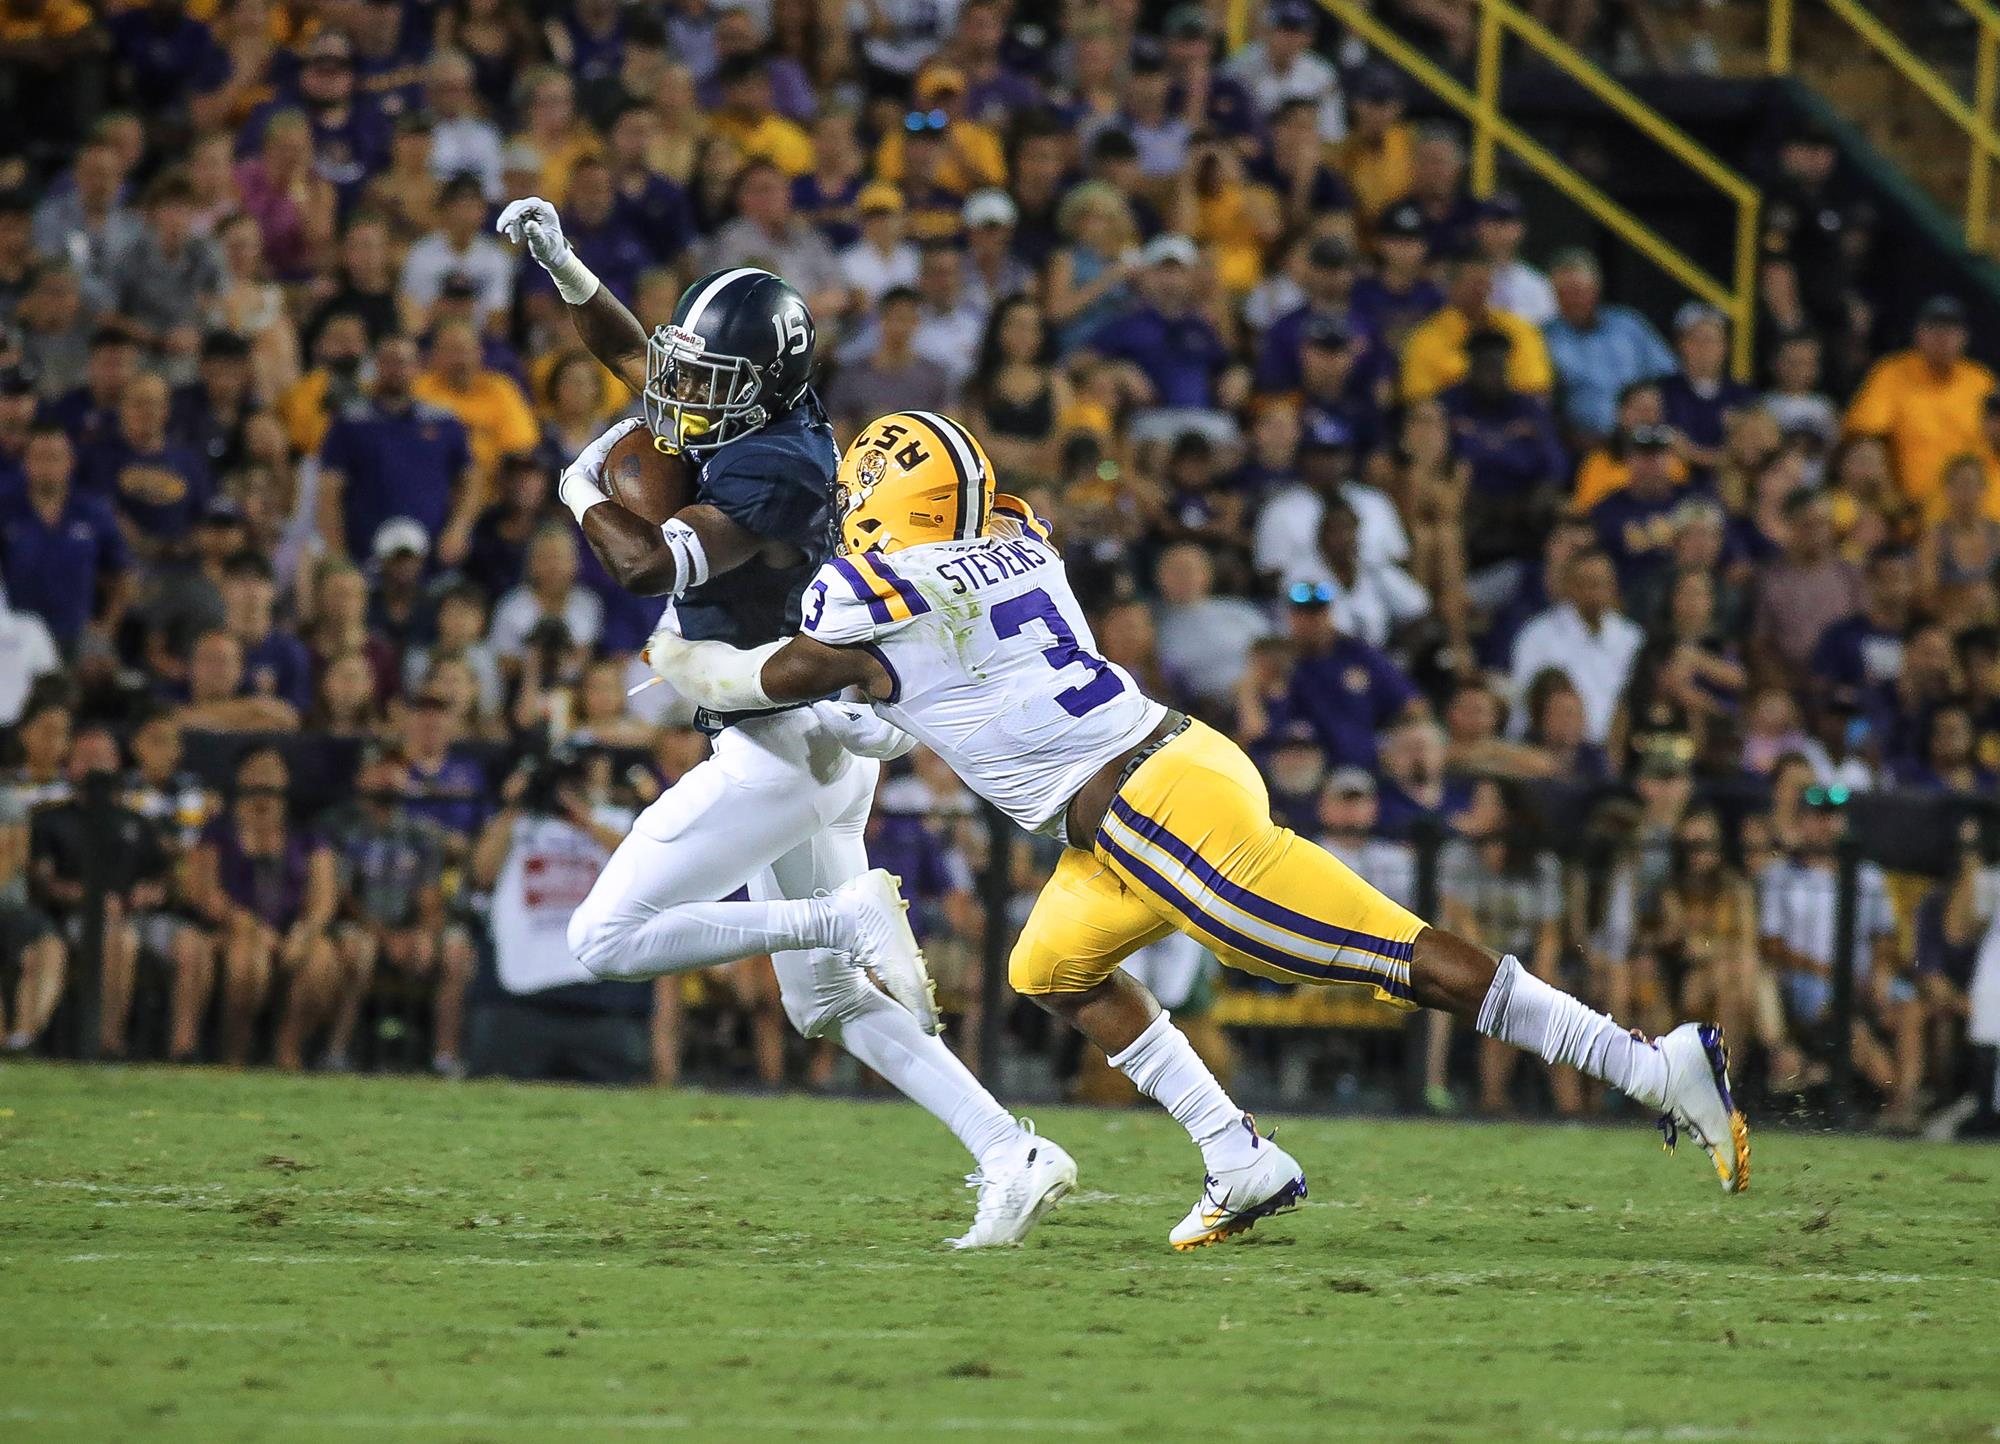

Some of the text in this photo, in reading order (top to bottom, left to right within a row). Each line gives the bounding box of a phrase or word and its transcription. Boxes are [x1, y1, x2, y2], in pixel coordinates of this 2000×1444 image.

[772, 306, 808, 357] 15
[936, 540, 1046, 595] STEVENS
[803, 579, 828, 632] 3
[990, 587, 1125, 718] 3
